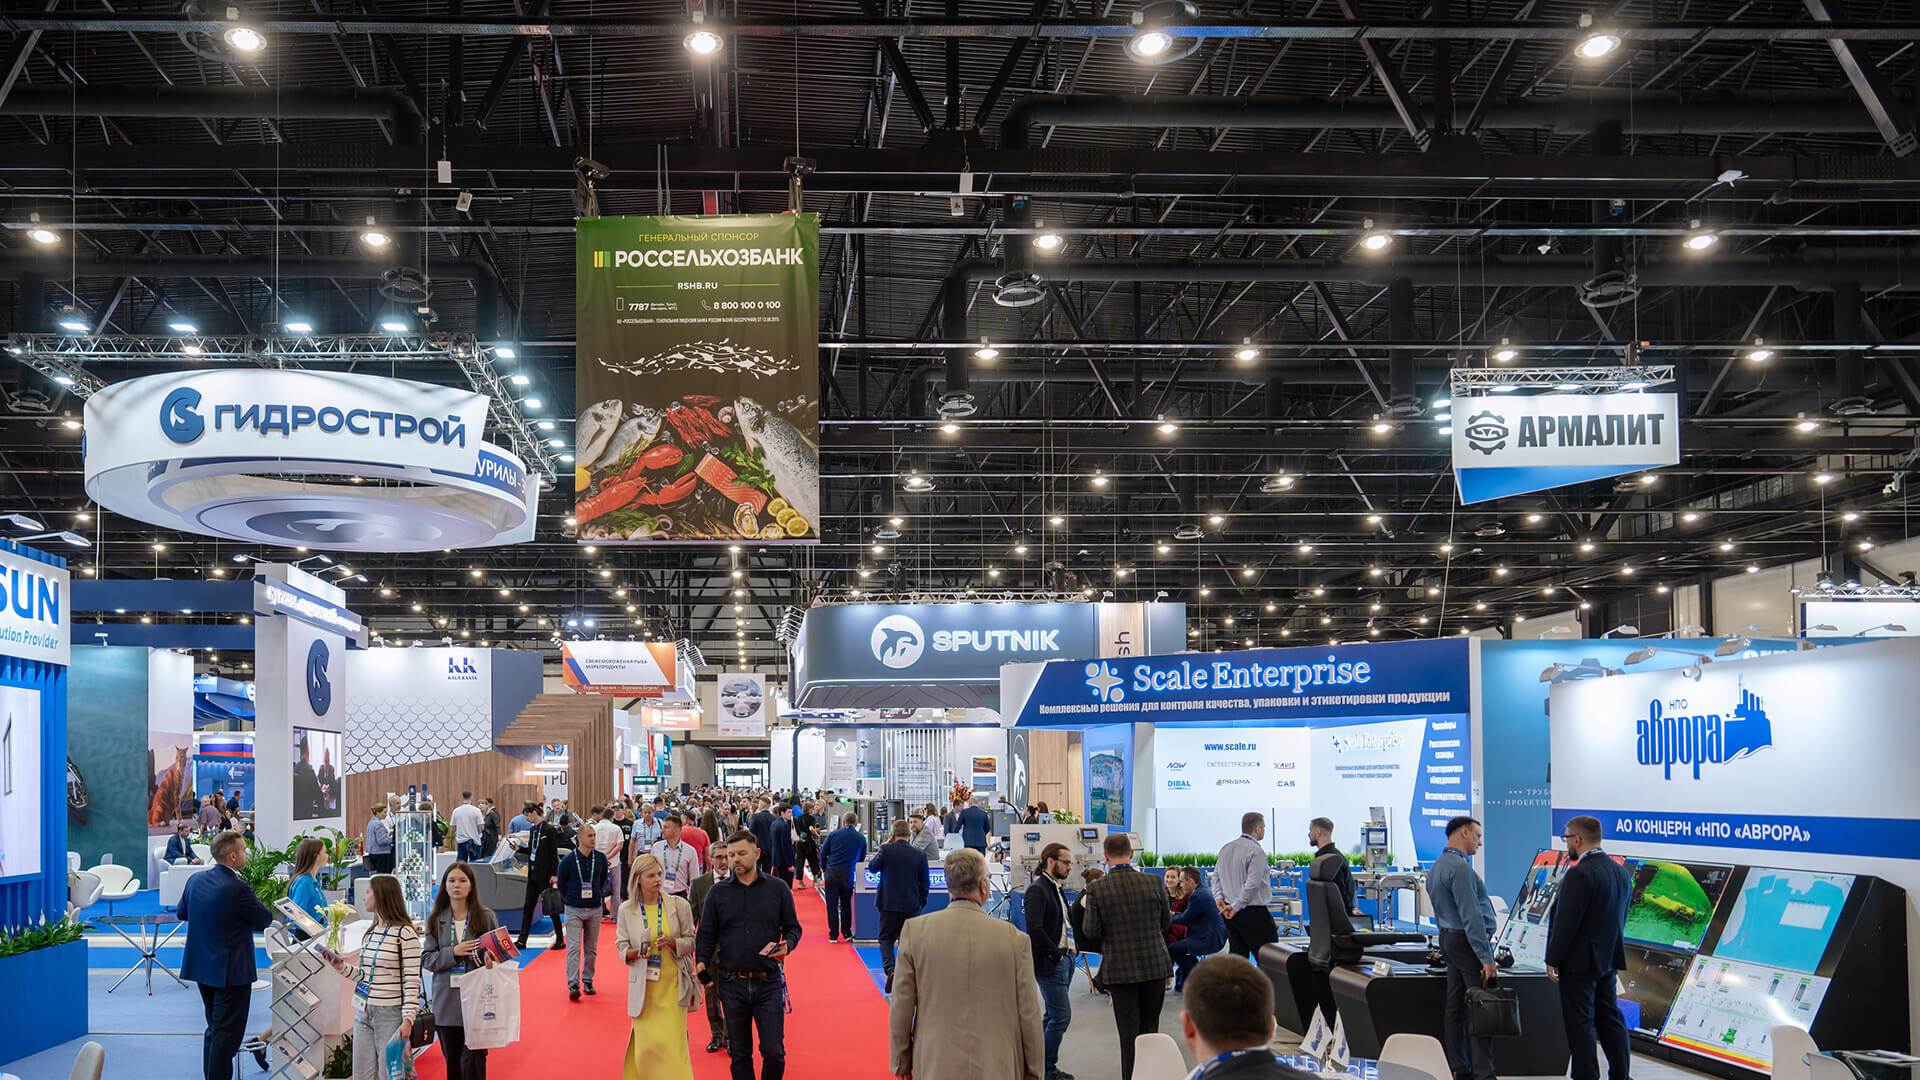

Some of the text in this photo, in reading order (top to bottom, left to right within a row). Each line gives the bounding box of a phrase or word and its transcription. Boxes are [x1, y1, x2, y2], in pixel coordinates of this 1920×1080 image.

[638, 232, 759, 242] ГЕНЕРАЛЬНЫЙ СПОНСОР
[615, 248, 804, 268] РОССЕЛЬХОЗБАНК
[677, 282, 718, 290] RSHB.RU
[628, 303, 649, 311] 7787
[713, 302, 719, 310] 8
[740, 301, 755, 309] 100
[757, 301, 764, 309] 0
[766, 301, 781, 309] 100
[214, 404, 466, 448] ГИДРОСТРОЙ
[1518, 413, 1664, 448] АРМАЛИТ
[23, 629, 59, 649] Provider
[932, 629, 1060, 652] SPUTNIK
[1133, 655, 1370, 693] Scale Enterprise
[1039, 691, 1450, 714] Комплексные решения для контроля качества, упаковки и этикетировки продукции
[1669, 699, 1688, 710] НПО
[1204, 742, 1257, 751] www.scale.ru
[1616, 818, 1811, 842] АО КОНЦЕРН «НПО «АВРОРА»
